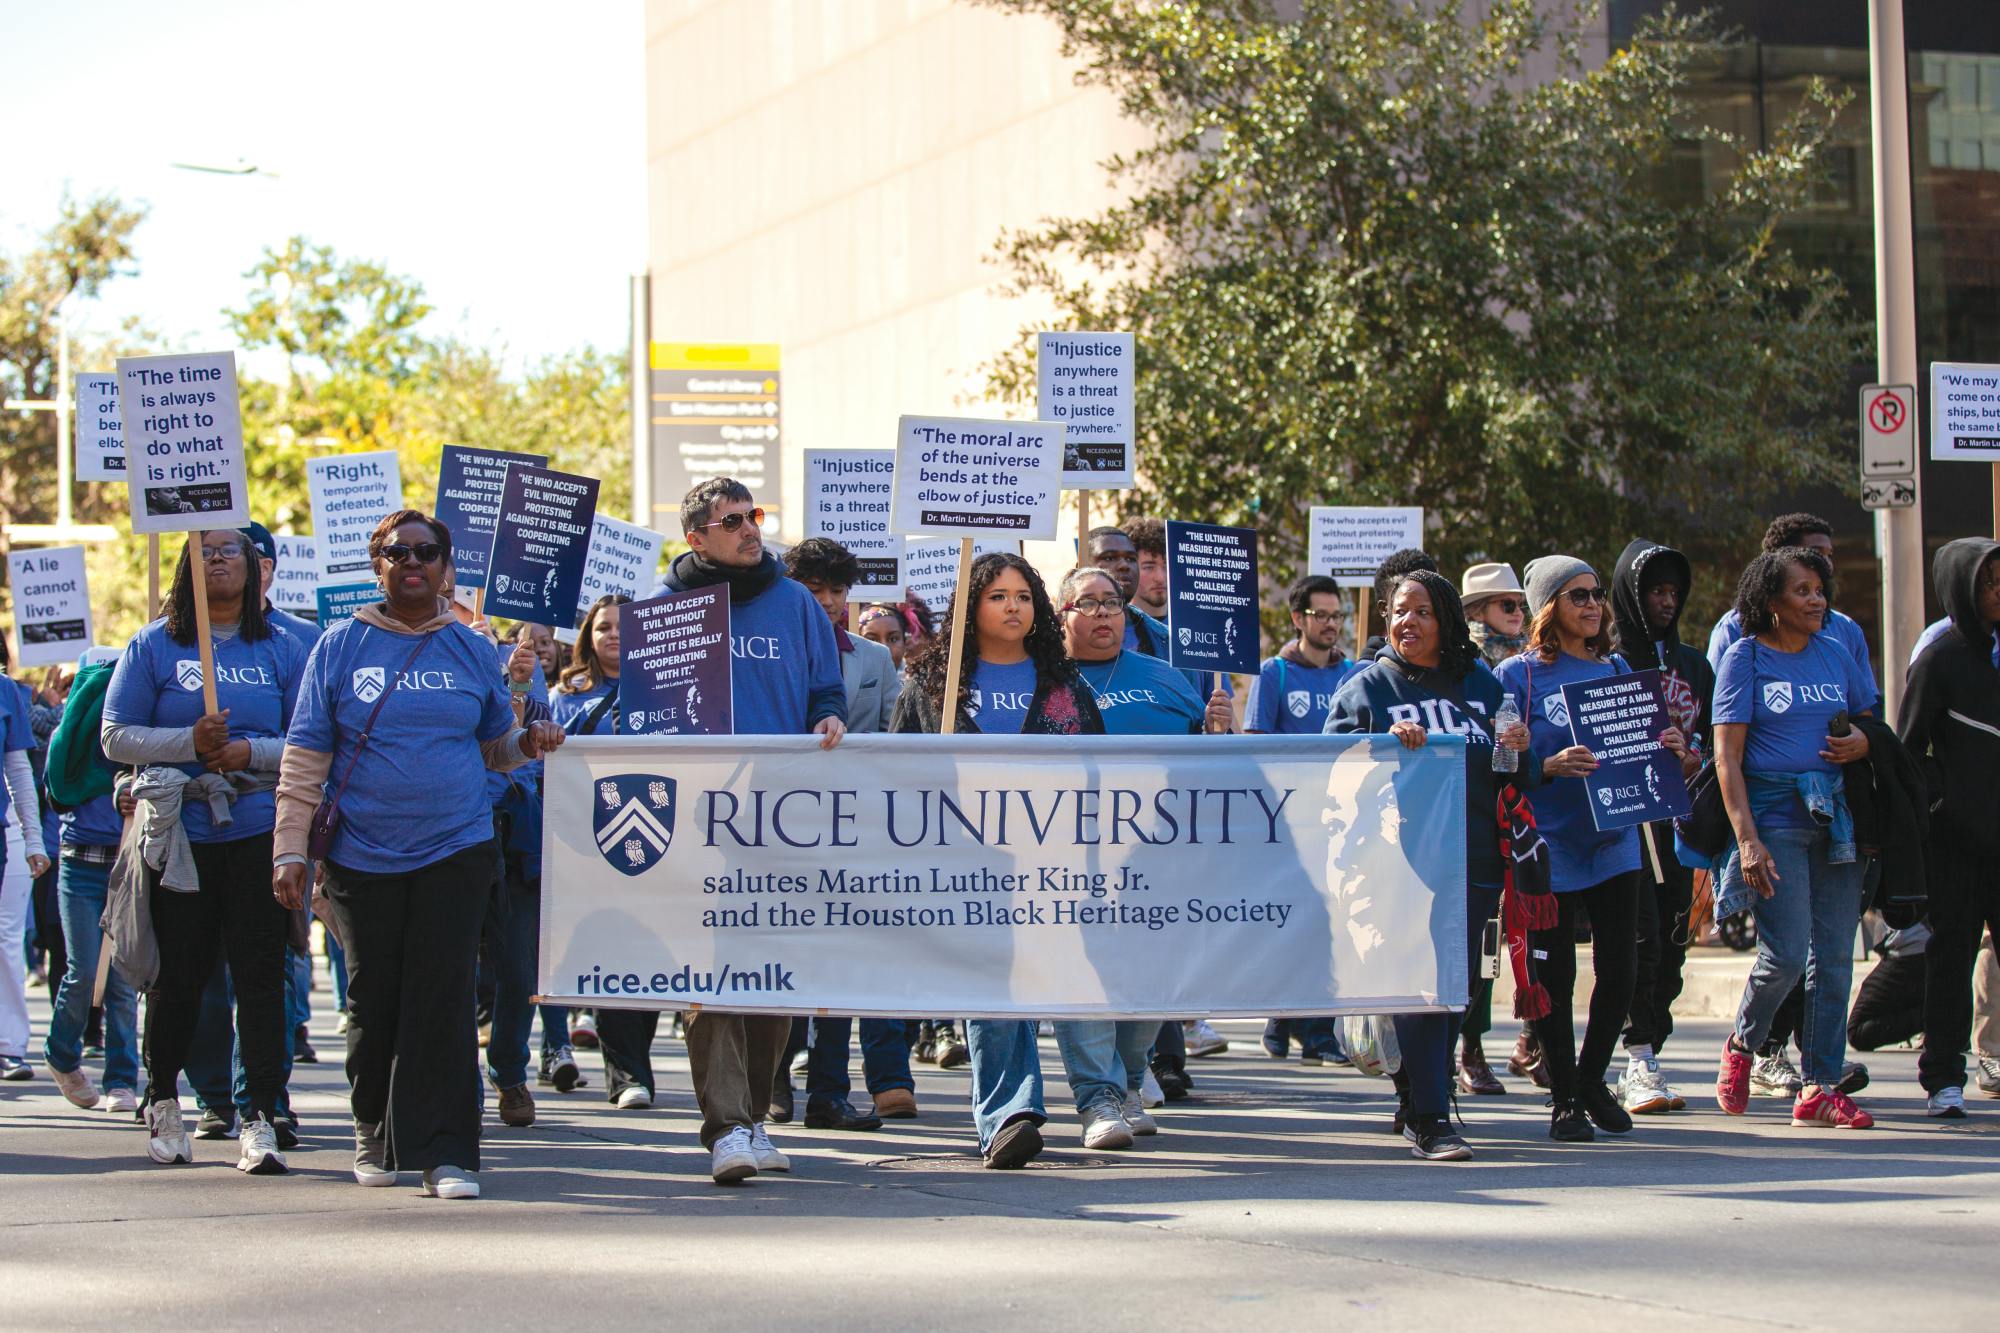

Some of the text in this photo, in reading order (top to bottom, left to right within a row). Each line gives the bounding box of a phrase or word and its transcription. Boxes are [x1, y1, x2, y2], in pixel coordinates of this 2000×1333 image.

[1047, 342, 1122, 359] “Injustice
[128, 367, 221, 386] “The time
[1054, 365, 1118, 379] anywhere
[1942, 374, 1998, 388] “We may
[1053, 385, 1118, 396] is a threat
[1948, 393, 1994, 402] come on
[142, 392, 215, 407] is always
[1054, 404, 1114, 418] to justice
[1948, 408, 1979, 418] ships,
[145, 413, 213, 434] right to
[1949, 422, 1994, 431] the same
[147, 436, 223, 456] do what
[914, 428, 1043, 448] “The moral arc
[922, 449, 1039, 467] of the universe
[149, 460, 229, 481] is right.”
[316, 462, 384, 481] “Right,
[814, 459, 894, 476] “Injustice
[519, 473, 588, 495] “HE WHO ACCEPTS
[920, 468, 1018, 485] bends at the
[323, 482, 388, 496] temporarily
[822, 482, 890, 495] anywhere
[326, 497, 389, 512] defeated,
[524, 488, 578, 506] EVIL WITHOUT
[918, 489, 1045, 506] elbow of justice.”
[525, 502, 572, 519] PROTESTING
[820, 501, 889, 512] is a threat
[327, 518, 337, 527] is
[506, 513, 586, 535] AGAINST REALLY
[822, 520, 886, 534] to justice
[941, 515, 965, 523] Martin
[968, 516, 994, 524] Luther
[996, 517, 1014, 526] King
[329, 531, 361, 544] than
[517, 528, 570, 546] COOPERATING
[624, 532, 651, 550] time
[1186, 531, 1238, 545] “THE ULTIMATE
[525, 543, 558, 556] WITH IT.”
[592, 540, 642, 564] is always
[1179, 543, 1247, 558] MEASURE OF MAN
[15, 558, 58, 573] “A lie
[588, 557, 635, 580] right to
[1185, 556, 1210, 566] WHERE
[1223, 560, 1250, 570] STANDS
[584, 576, 600, 588] do
[1196, 569, 1241, 581] MOMENTS OF
[24, 580, 76, 596] cannot
[512, 580, 536, 594] RICE
[1194, 581, 1235, 592] CHALLENGE
[497, 597, 534, 608] rice.edu/mlk
[634, 595, 715, 618] “HE WHO ACCEPTS
[1180, 592, 1250, 606] AND CONTROVERSY.”
[26, 601, 67, 618] live.”
[643, 610, 706, 630] EVIL WITHOUT
[647, 624, 702, 643] PROTESTING
[1195, 632, 1217, 644] RICE
[628, 632, 722, 660] AGAINST REALLY
[1183, 650, 1219, 658] rice.edu/mlk
[644, 650, 706, 670] COOPERATING
[218, 665, 271, 685] RICE
[395, 671, 456, 690] RICE
[656, 665, 695, 681] WITH IT.”
[1104, 690, 1158, 706] RICE
[1585, 682, 1642, 698] “THE ULTIMATE
[1799, 684, 1845, 702] RICE
[1580, 692, 1653, 712] MEASURE OF MAN
[649, 707, 677, 723] RICE
[1589, 704, 1658, 723] WHERE HE STANDS
[1603, 717, 1652, 734] MOMENTS OF
[1604, 731, 1648, 746] CHALLENGE
[1616, 785, 1641, 800] RICE
[1607, 803, 1646, 815] rice.edu/mlk
[702, 788, 1297, 847] RICE UNIVERSITY
[703, 866, 1150, 898] salutes Martin Luther King Jr.
[702, 898, 1292, 930] and the Houston Black Heritage Society
[577, 963, 795, 995] rice.edu/mlk
